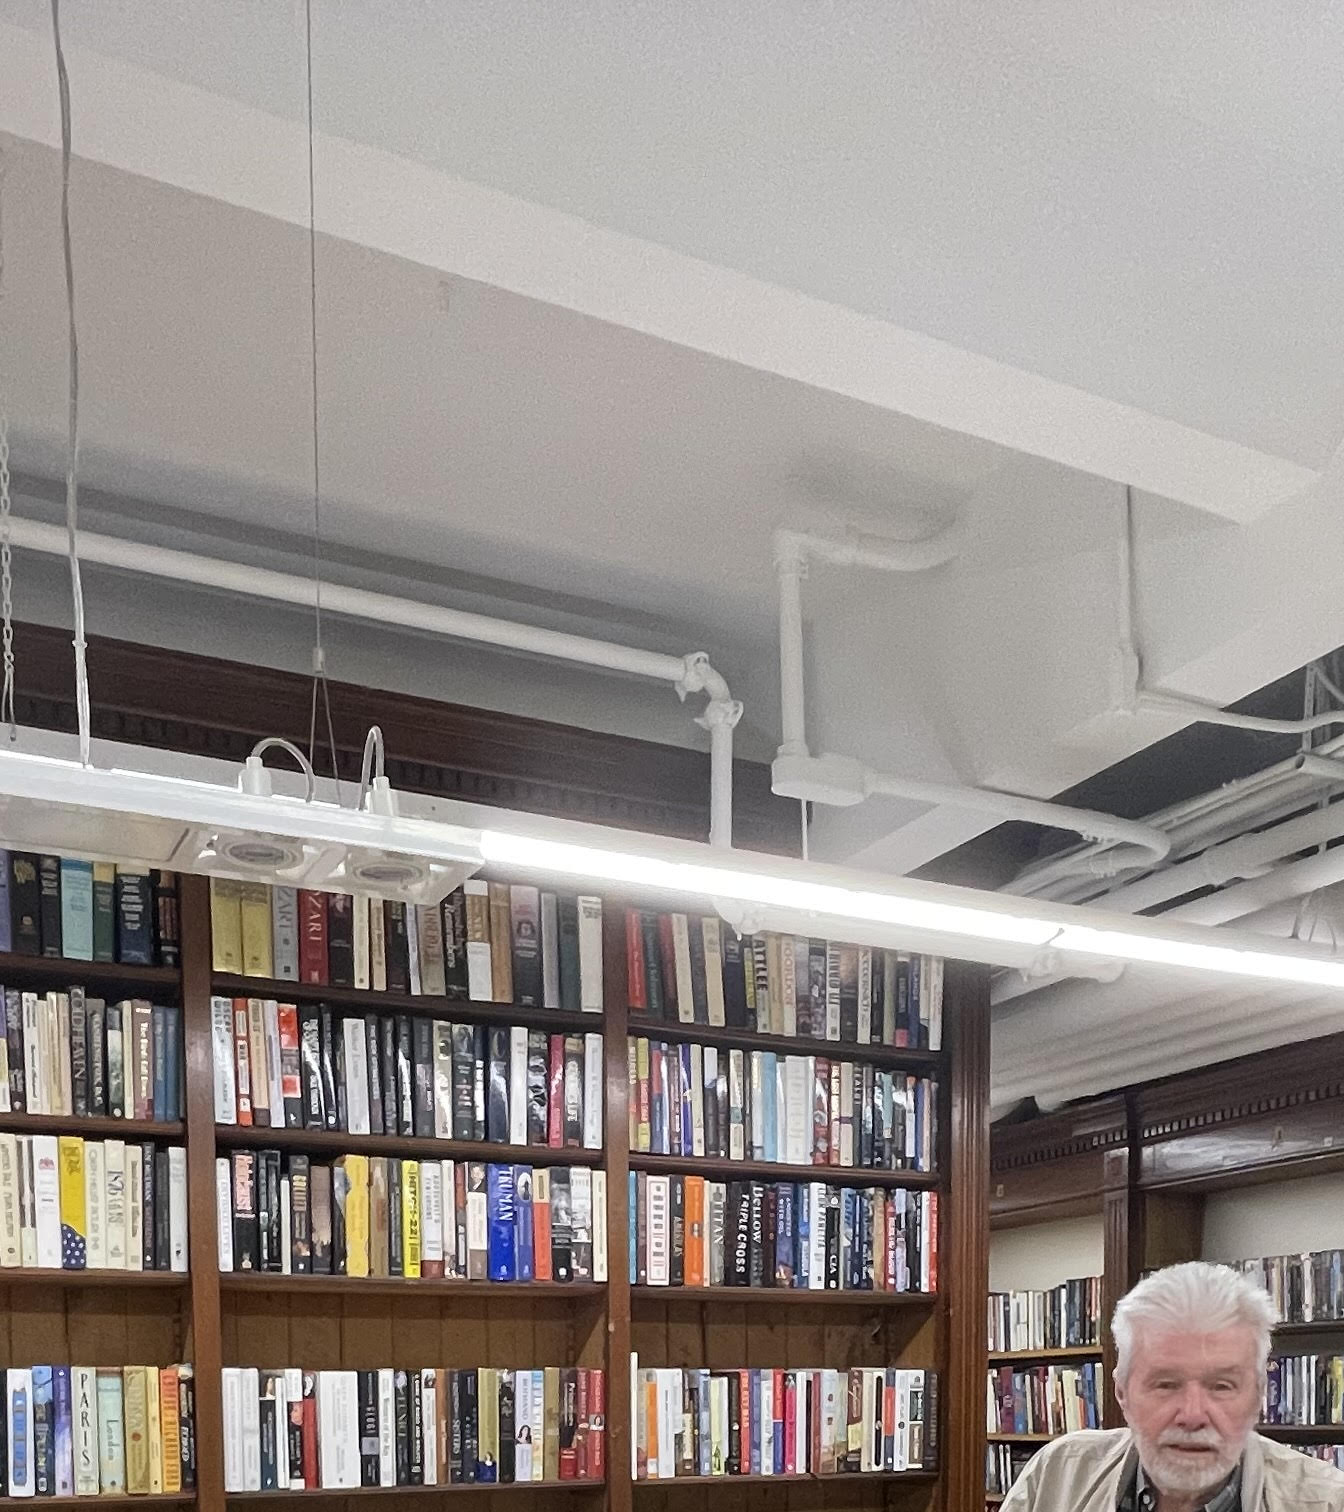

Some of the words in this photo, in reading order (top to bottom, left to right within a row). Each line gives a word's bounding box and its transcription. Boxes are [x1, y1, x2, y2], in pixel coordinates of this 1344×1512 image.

[498, 1165, 514, 1222] TRUMAN
[739, 1195, 751, 1231] TRIPLE
[713, 1200, 724, 1245] TITAN
[736, 1233, 748, 1274] CROSS
[831, 1254, 840, 1274] CIA
[79, 1373, 92, 1466] PARIS
[106, 1419, 120, 1461] London
